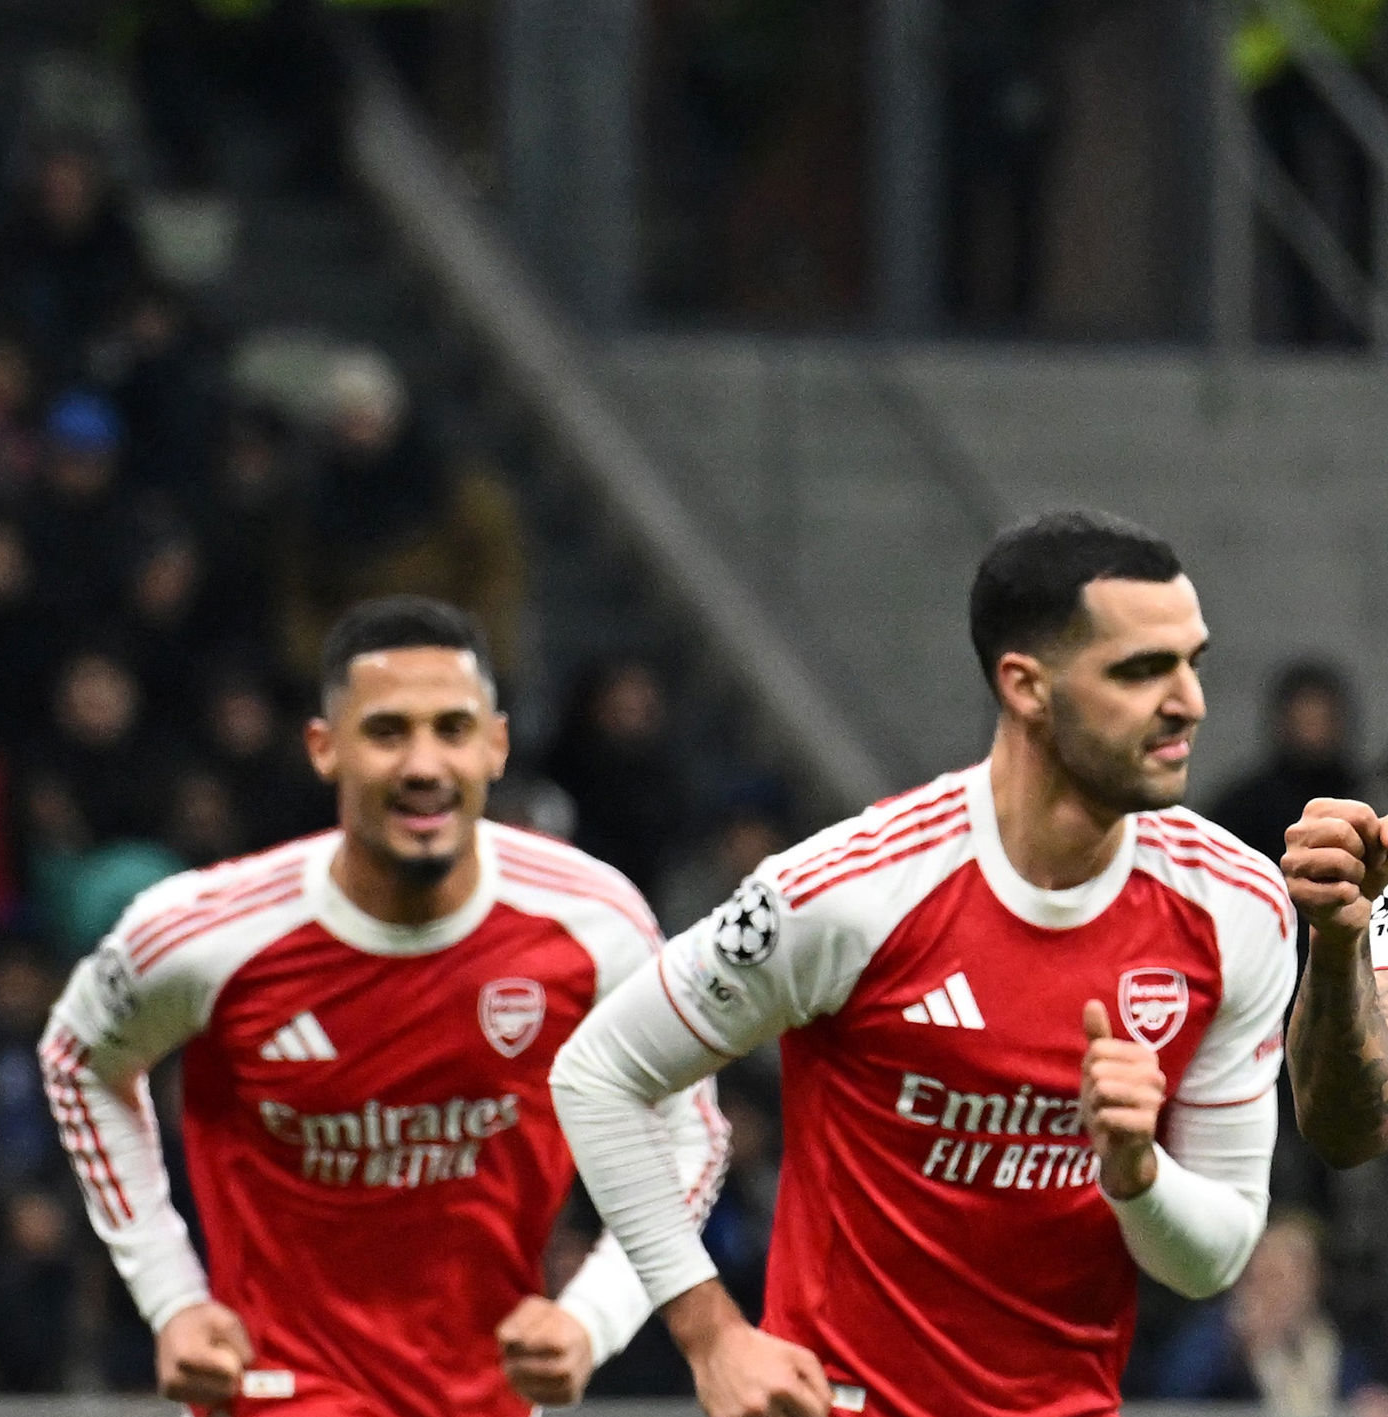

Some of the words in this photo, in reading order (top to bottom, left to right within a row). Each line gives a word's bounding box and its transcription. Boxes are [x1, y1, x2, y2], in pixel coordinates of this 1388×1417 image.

[259, 1093, 520, 1150] Emirates
[895, 1072, 1084, 1136] Emira
[922, 1137, 993, 1185] FLY
